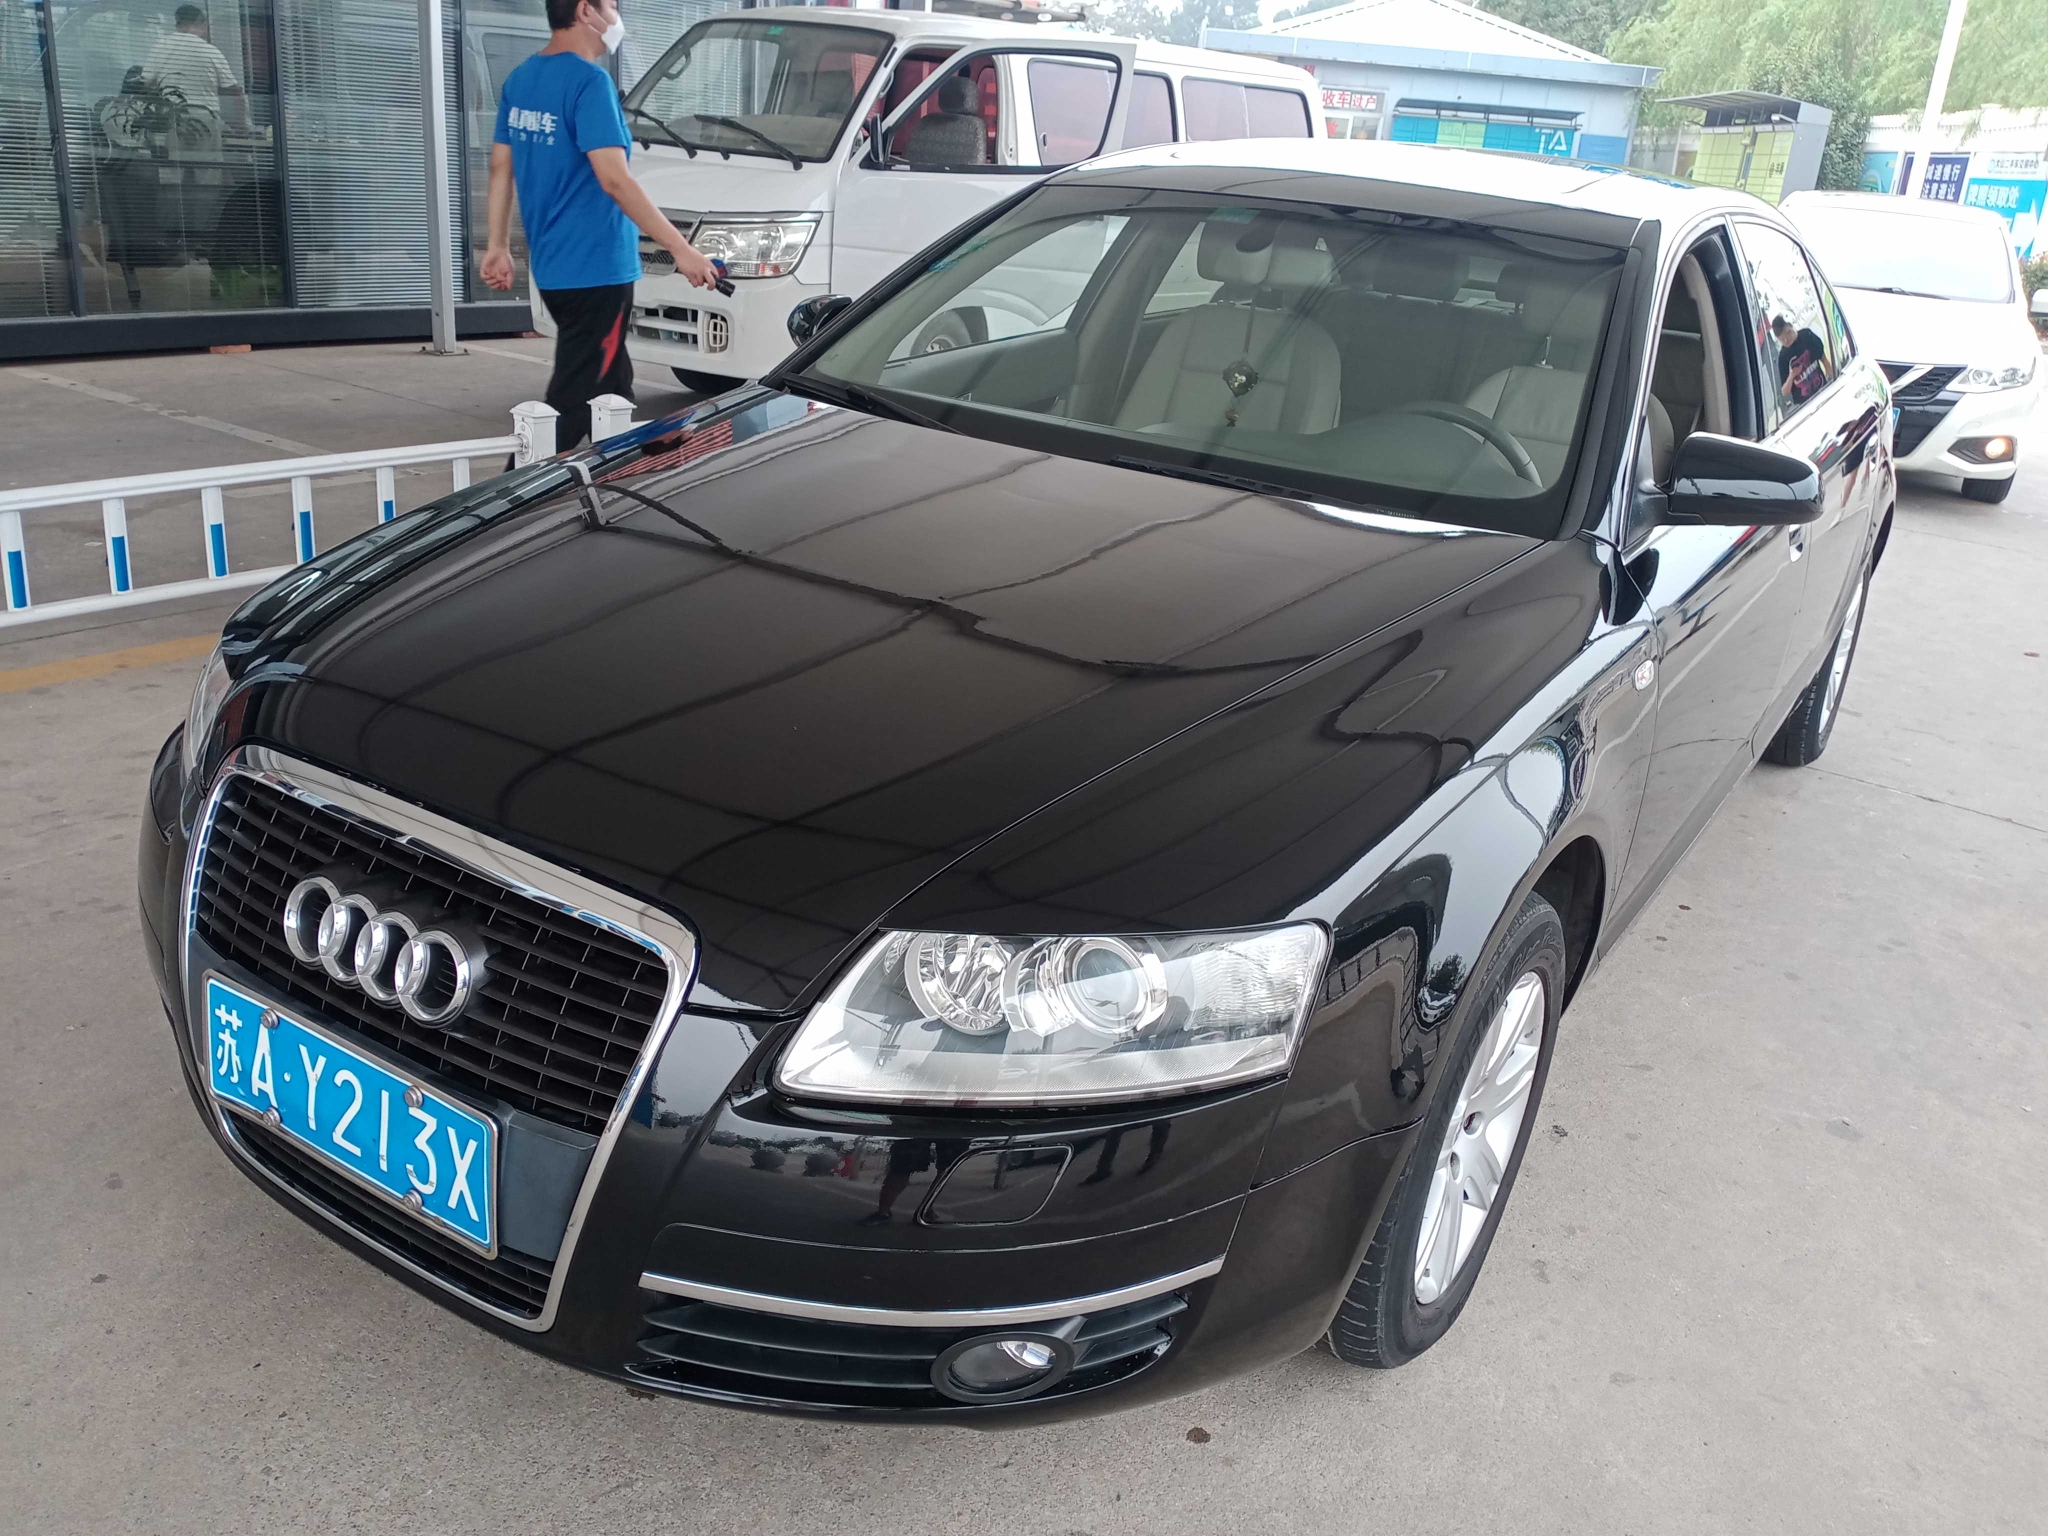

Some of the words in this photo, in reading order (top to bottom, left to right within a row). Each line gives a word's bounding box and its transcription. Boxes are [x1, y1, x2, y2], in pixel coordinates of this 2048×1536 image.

[1322, 90, 1377, 109] 收车过户
[1925, 163, 1962, 182] 减速慢行
[214, 1003, 480, 1223] 苏A·Y213X
